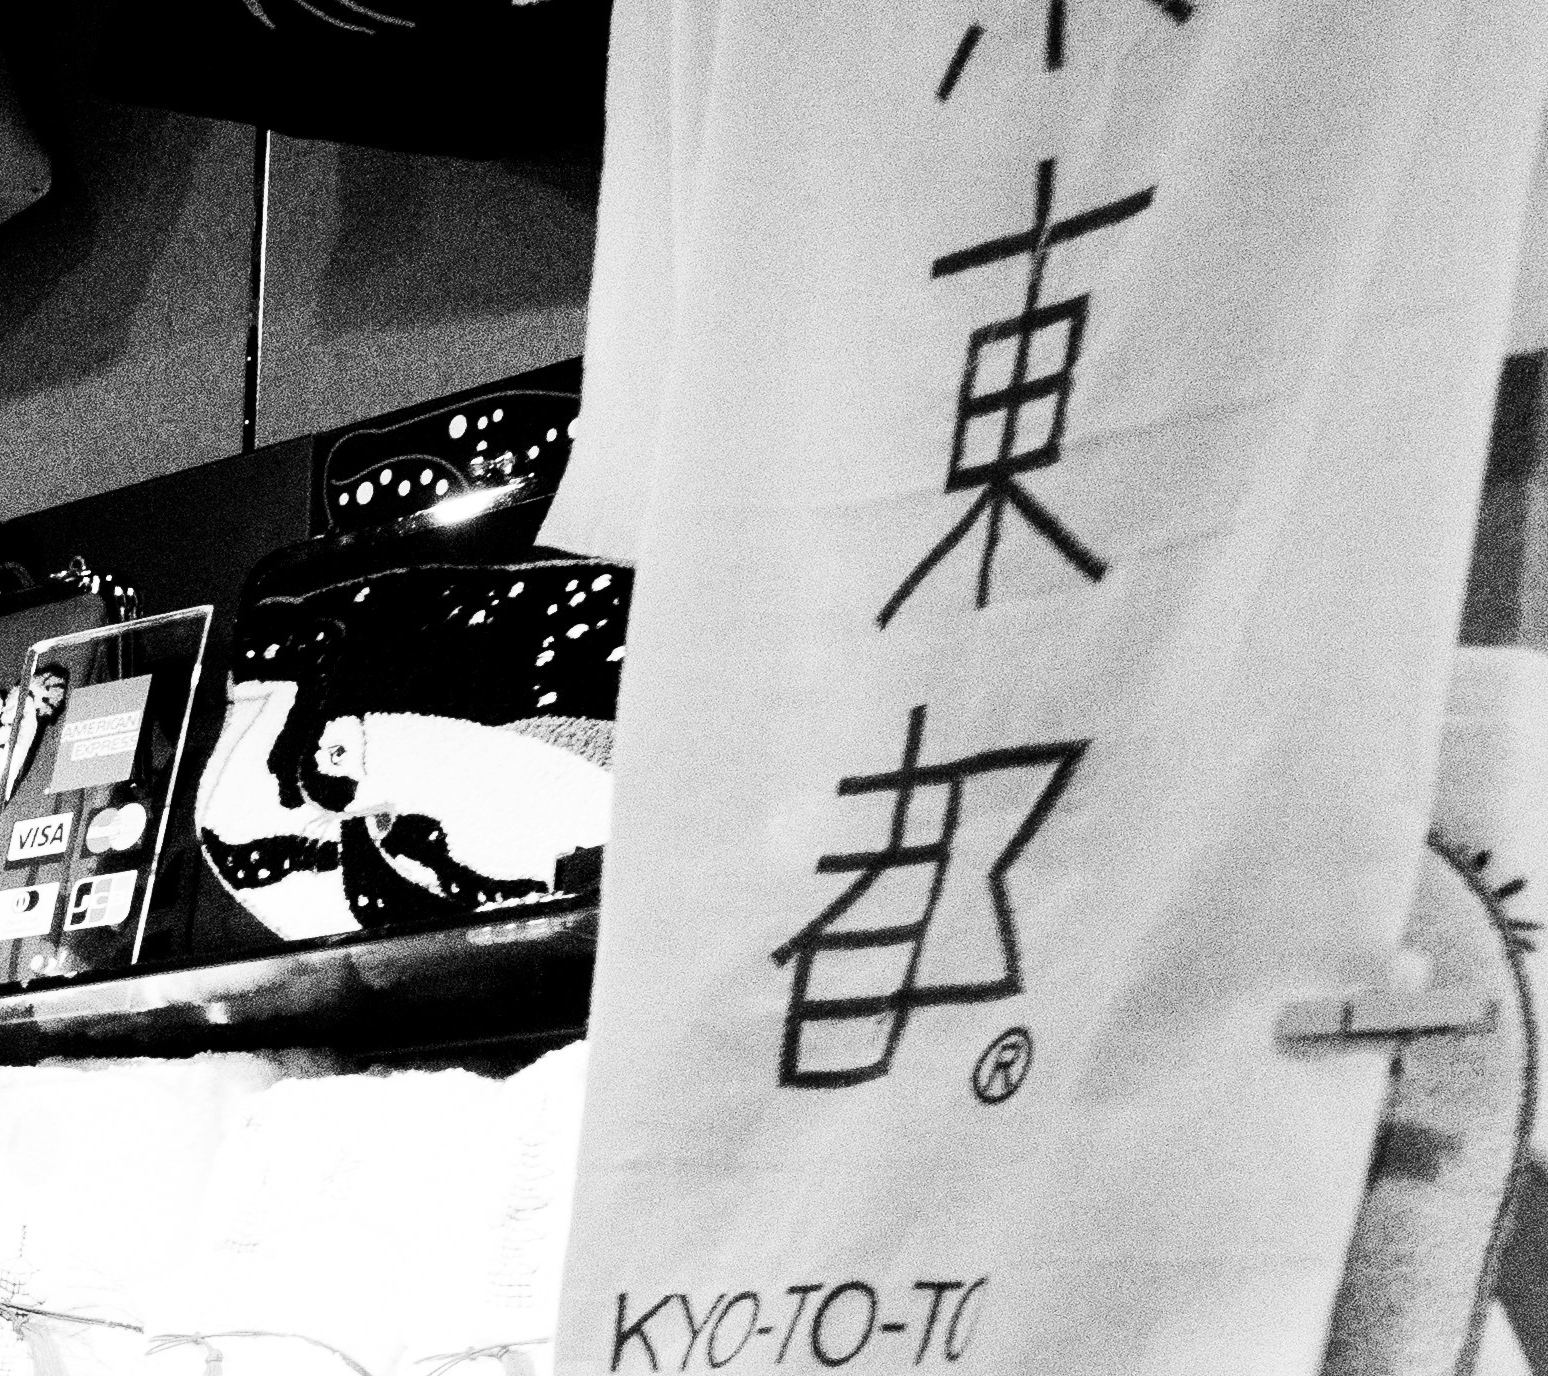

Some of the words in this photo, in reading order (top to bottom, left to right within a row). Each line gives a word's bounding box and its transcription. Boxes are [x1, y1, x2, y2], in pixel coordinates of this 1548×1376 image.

[63, 710, 140, 742] AMERICAN
[71, 733, 137, 761] EXPRESS
[18, 823, 64, 850] VISA
